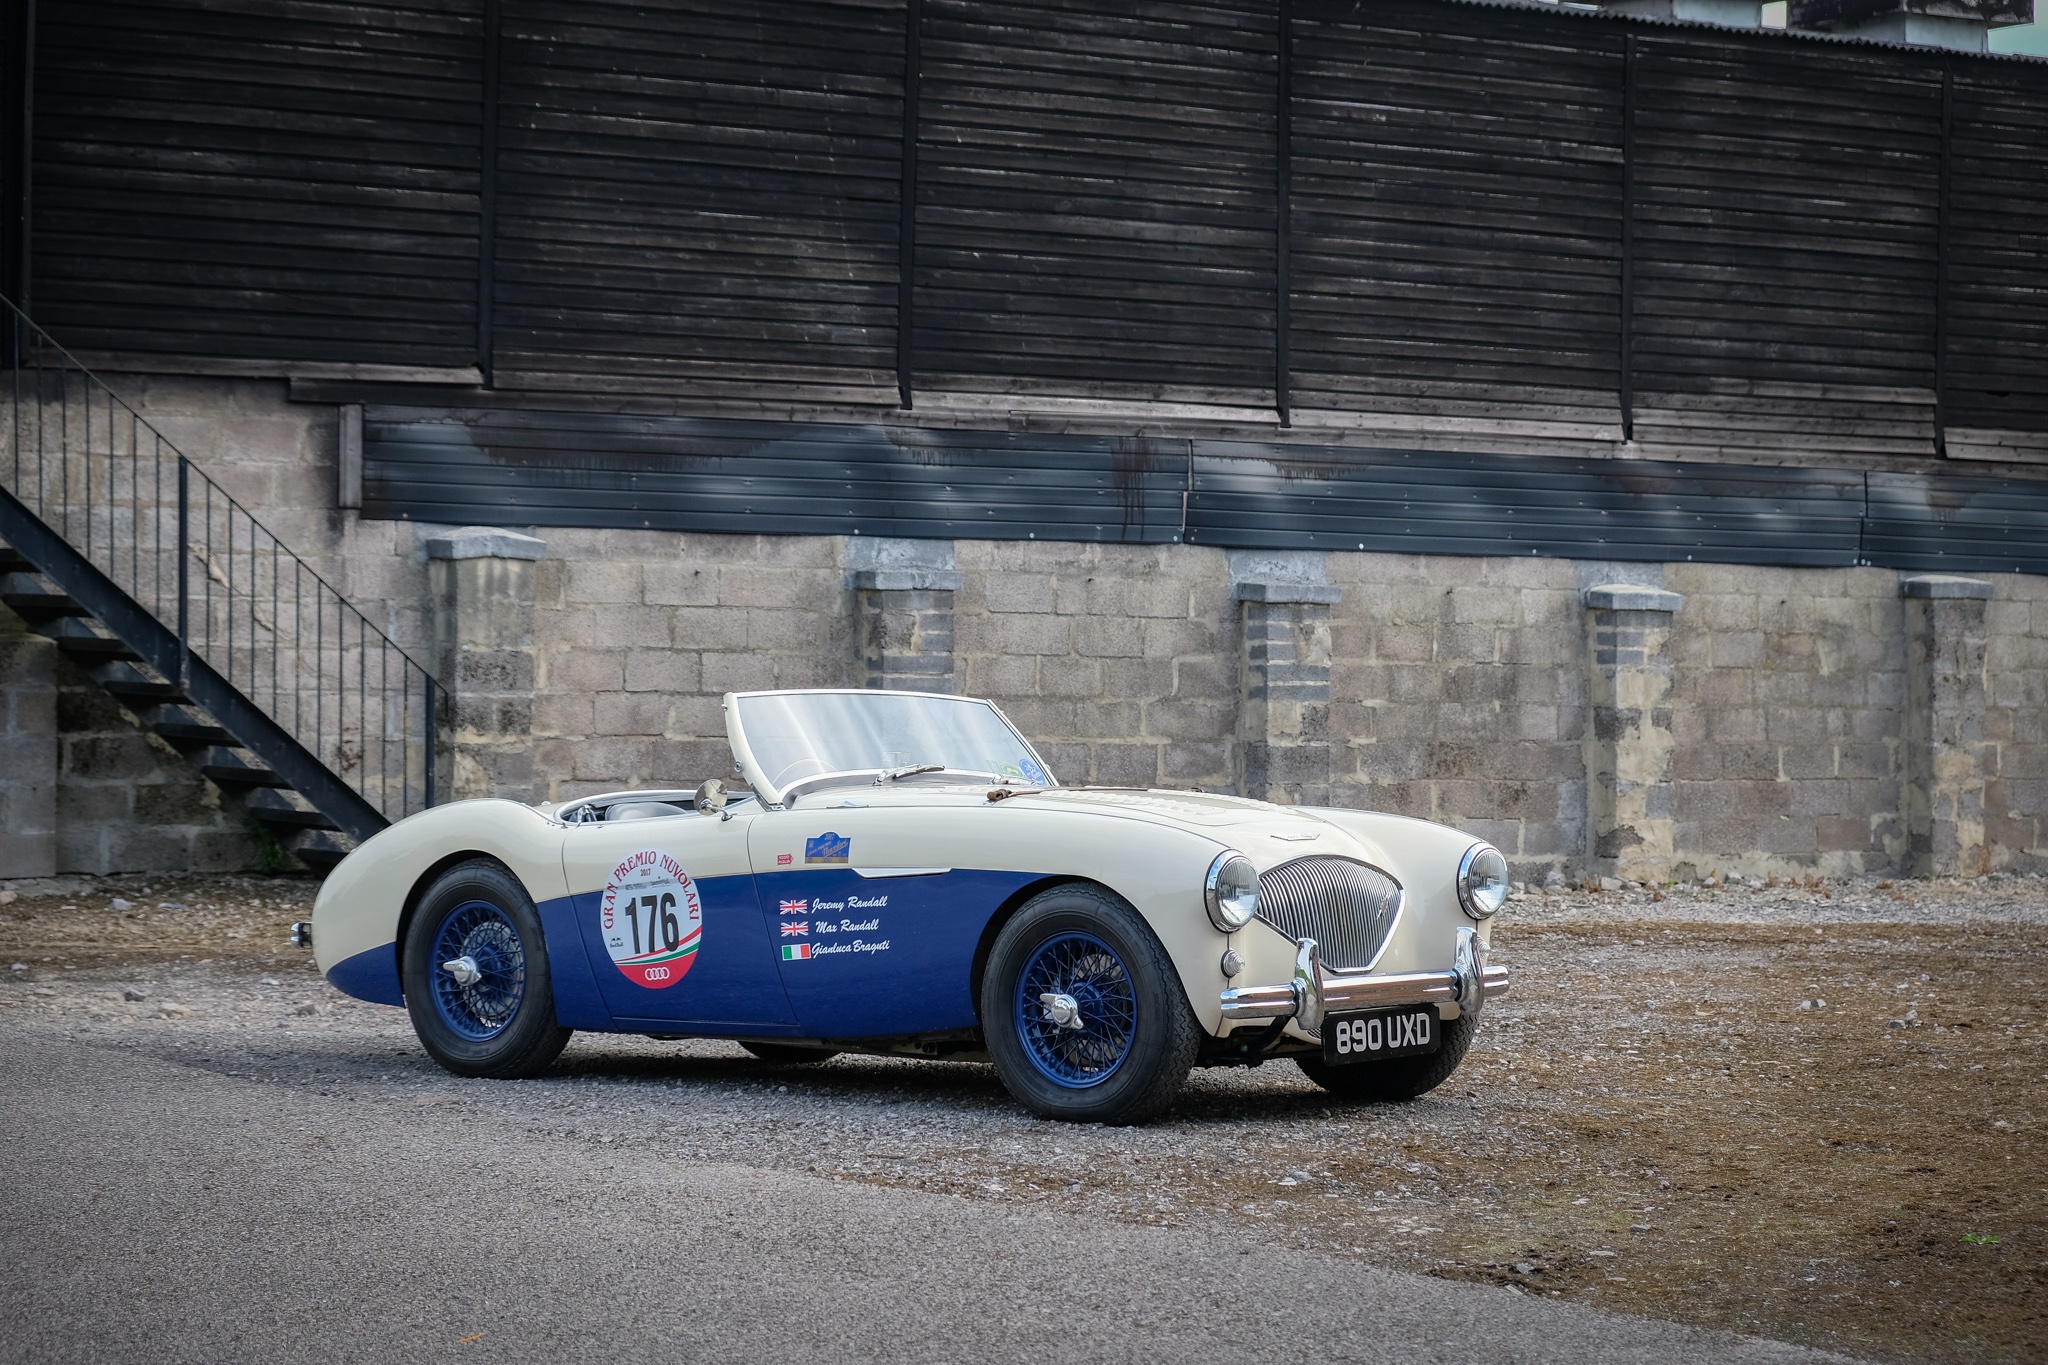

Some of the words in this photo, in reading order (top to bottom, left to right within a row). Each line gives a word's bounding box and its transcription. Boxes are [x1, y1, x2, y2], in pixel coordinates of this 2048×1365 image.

[640, 868, 651, 877] 2017
[604, 882, 618, 929] GRAN
[614, 851, 657, 882] PREMIO
[660, 854, 699, 920] NUVOLARI
[811, 897, 845, 914] Jeremy
[847, 895, 888, 908] Randall
[625, 892, 680, 954] 176
[815, 920, 838, 934] Max
[840, 918, 879, 932] Randall
[811, 942, 852, 958] Gianluca
[852, 939, 890, 955] Braguti
[1336, 1018, 1382, 1054] 890
[1387, 1012, 1431, 1048] UXD
